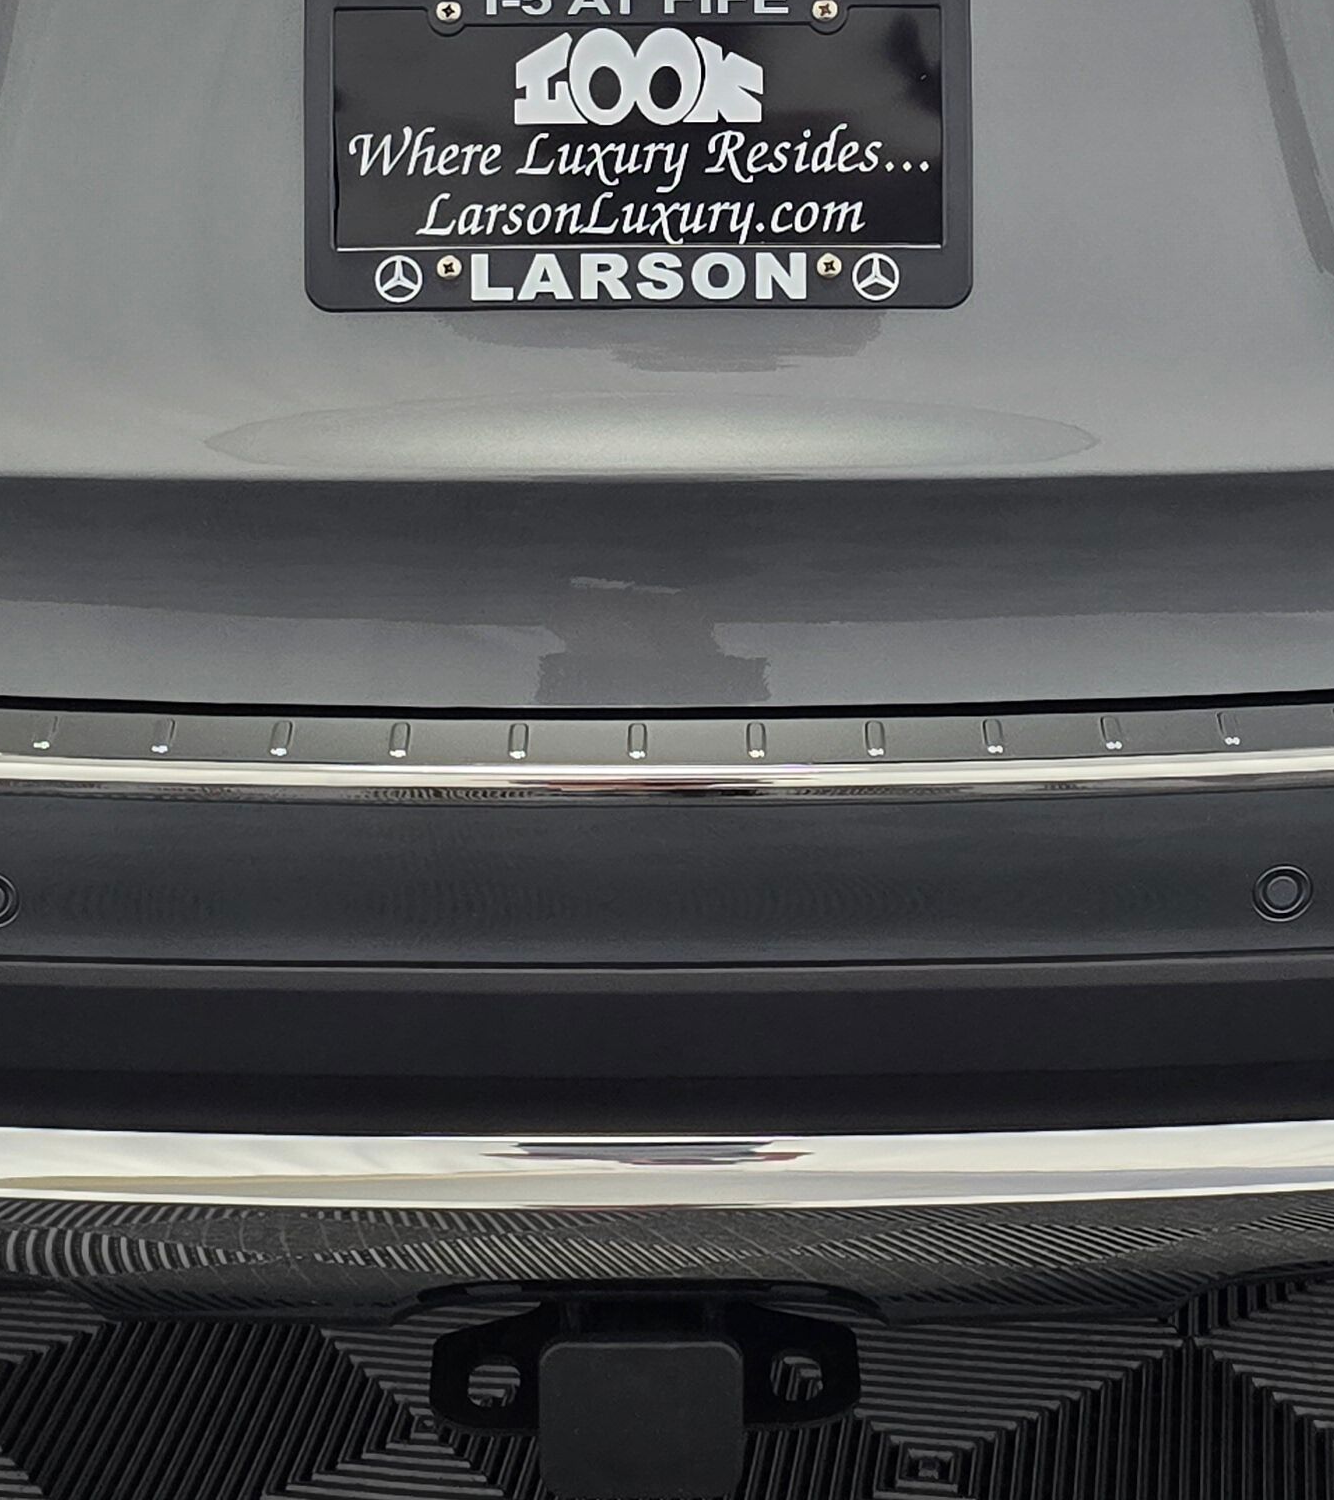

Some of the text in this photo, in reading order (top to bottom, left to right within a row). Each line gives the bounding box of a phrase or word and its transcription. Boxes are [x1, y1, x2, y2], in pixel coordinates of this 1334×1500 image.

[513, 27, 764, 126] LOOK
[348, 123, 931, 194] Where Luxury Resides...
[415, 191, 866, 245] LarsonLuxury.com
[470, 251, 808, 302] LARSON
